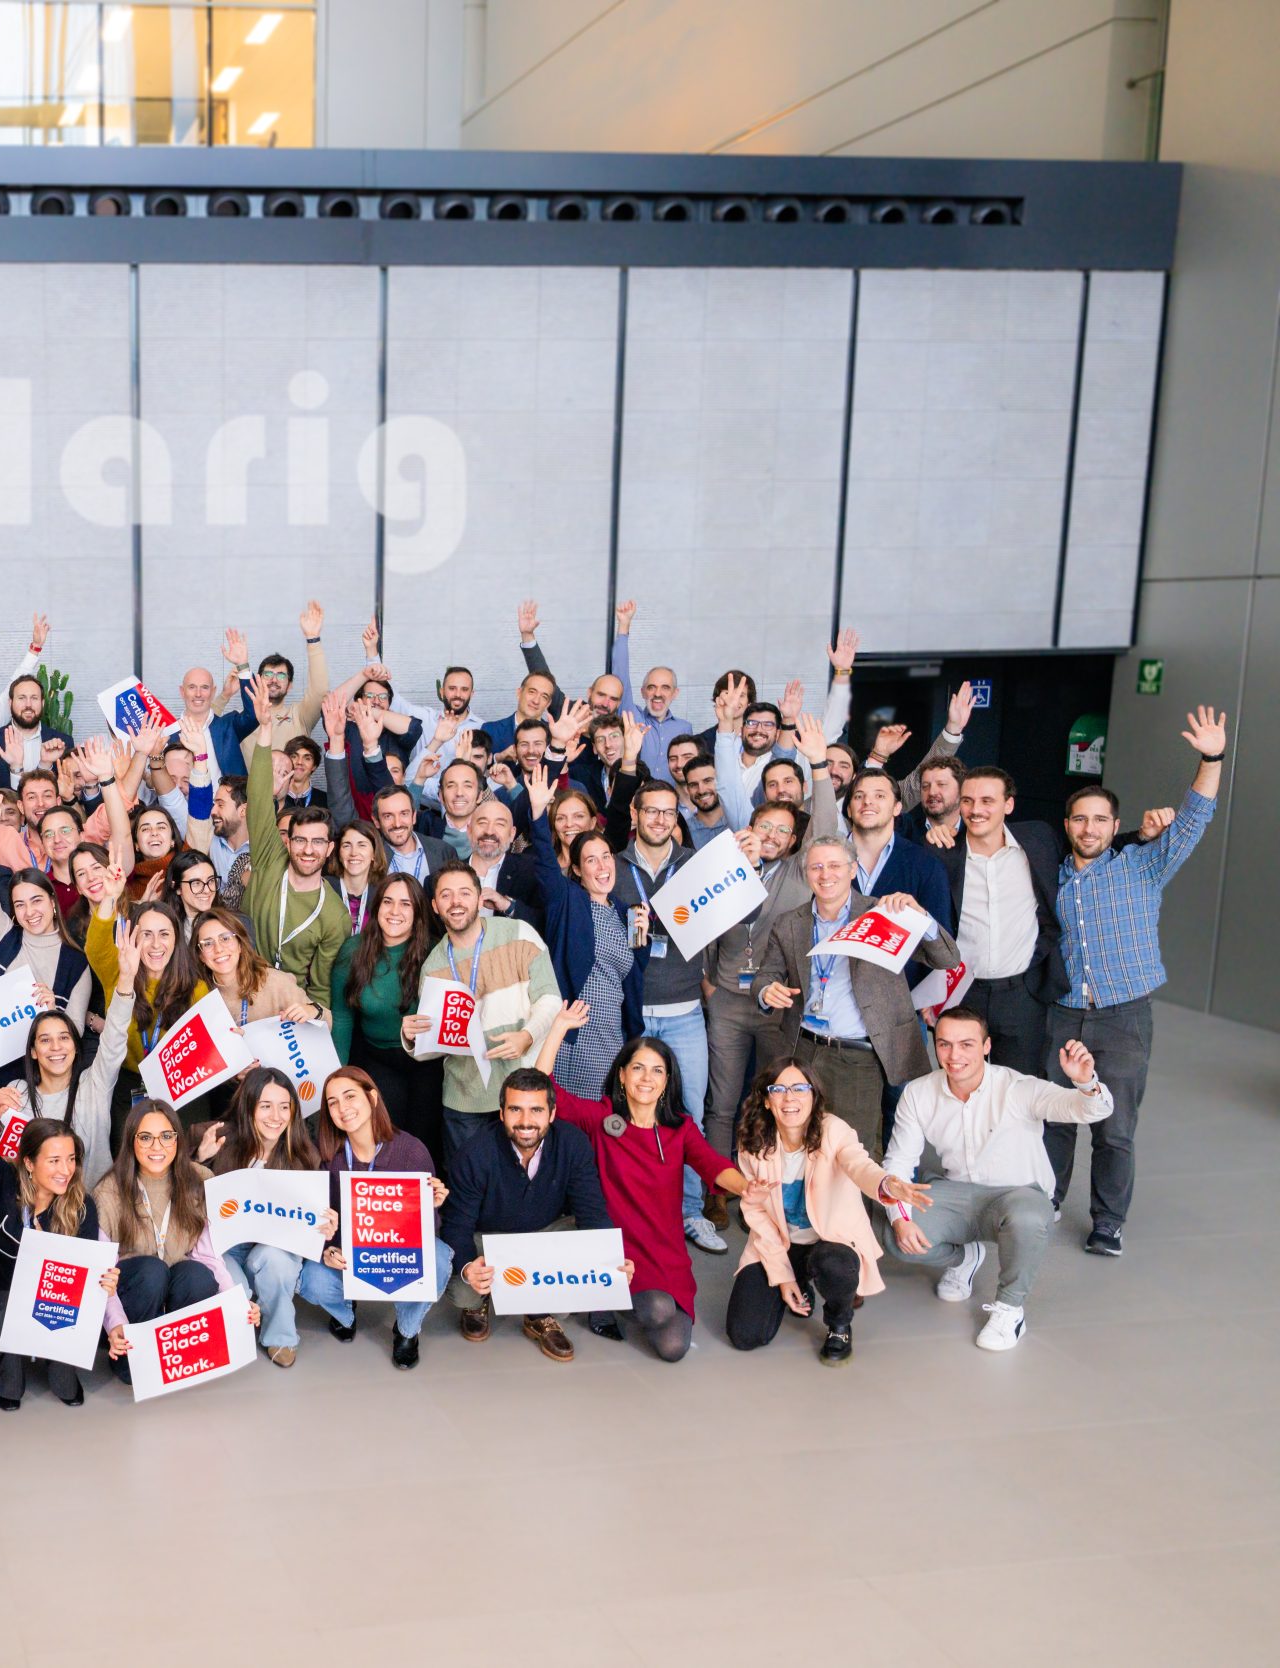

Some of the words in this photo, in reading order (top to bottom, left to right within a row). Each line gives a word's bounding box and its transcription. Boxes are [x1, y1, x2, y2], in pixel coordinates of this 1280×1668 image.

[127, 693, 145, 721] Certifi
[690, 867, 747, 913] Solarig
[848, 918, 874, 940] Place
[864, 934, 882, 945] To
[447, 993, 474, 1008] Gre
[447, 1006, 471, 1019] Pla
[444, 1020, 461, 1031] To
[161, 1026, 193, 1063] Great
[442, 1032, 467, 1044] Wo
[165, 1040, 197, 1073] Place
[279, 1021, 309, 1078] Solarig
[168, 1068, 182, 1082] To
[2, 1143, 18, 1159] To
[355, 1182, 403, 1196] Great
[356, 1197, 403, 1212] Place
[243, 1199, 317, 1226] Solarig
[355, 1213, 374, 1226] To
[359, 1252, 417, 1264] Certified
[45, 1262, 77, 1277] Great
[42, 1280, 54, 1289] To
[43, 1272, 74, 1284] Place
[532, 1269, 613, 1287] Solarig
[38, 1303, 75, 1316] Certified
[158, 1316, 208, 1341] Great
[161, 1332, 210, 1355] Place
[162, 1354, 182, 1367] To
